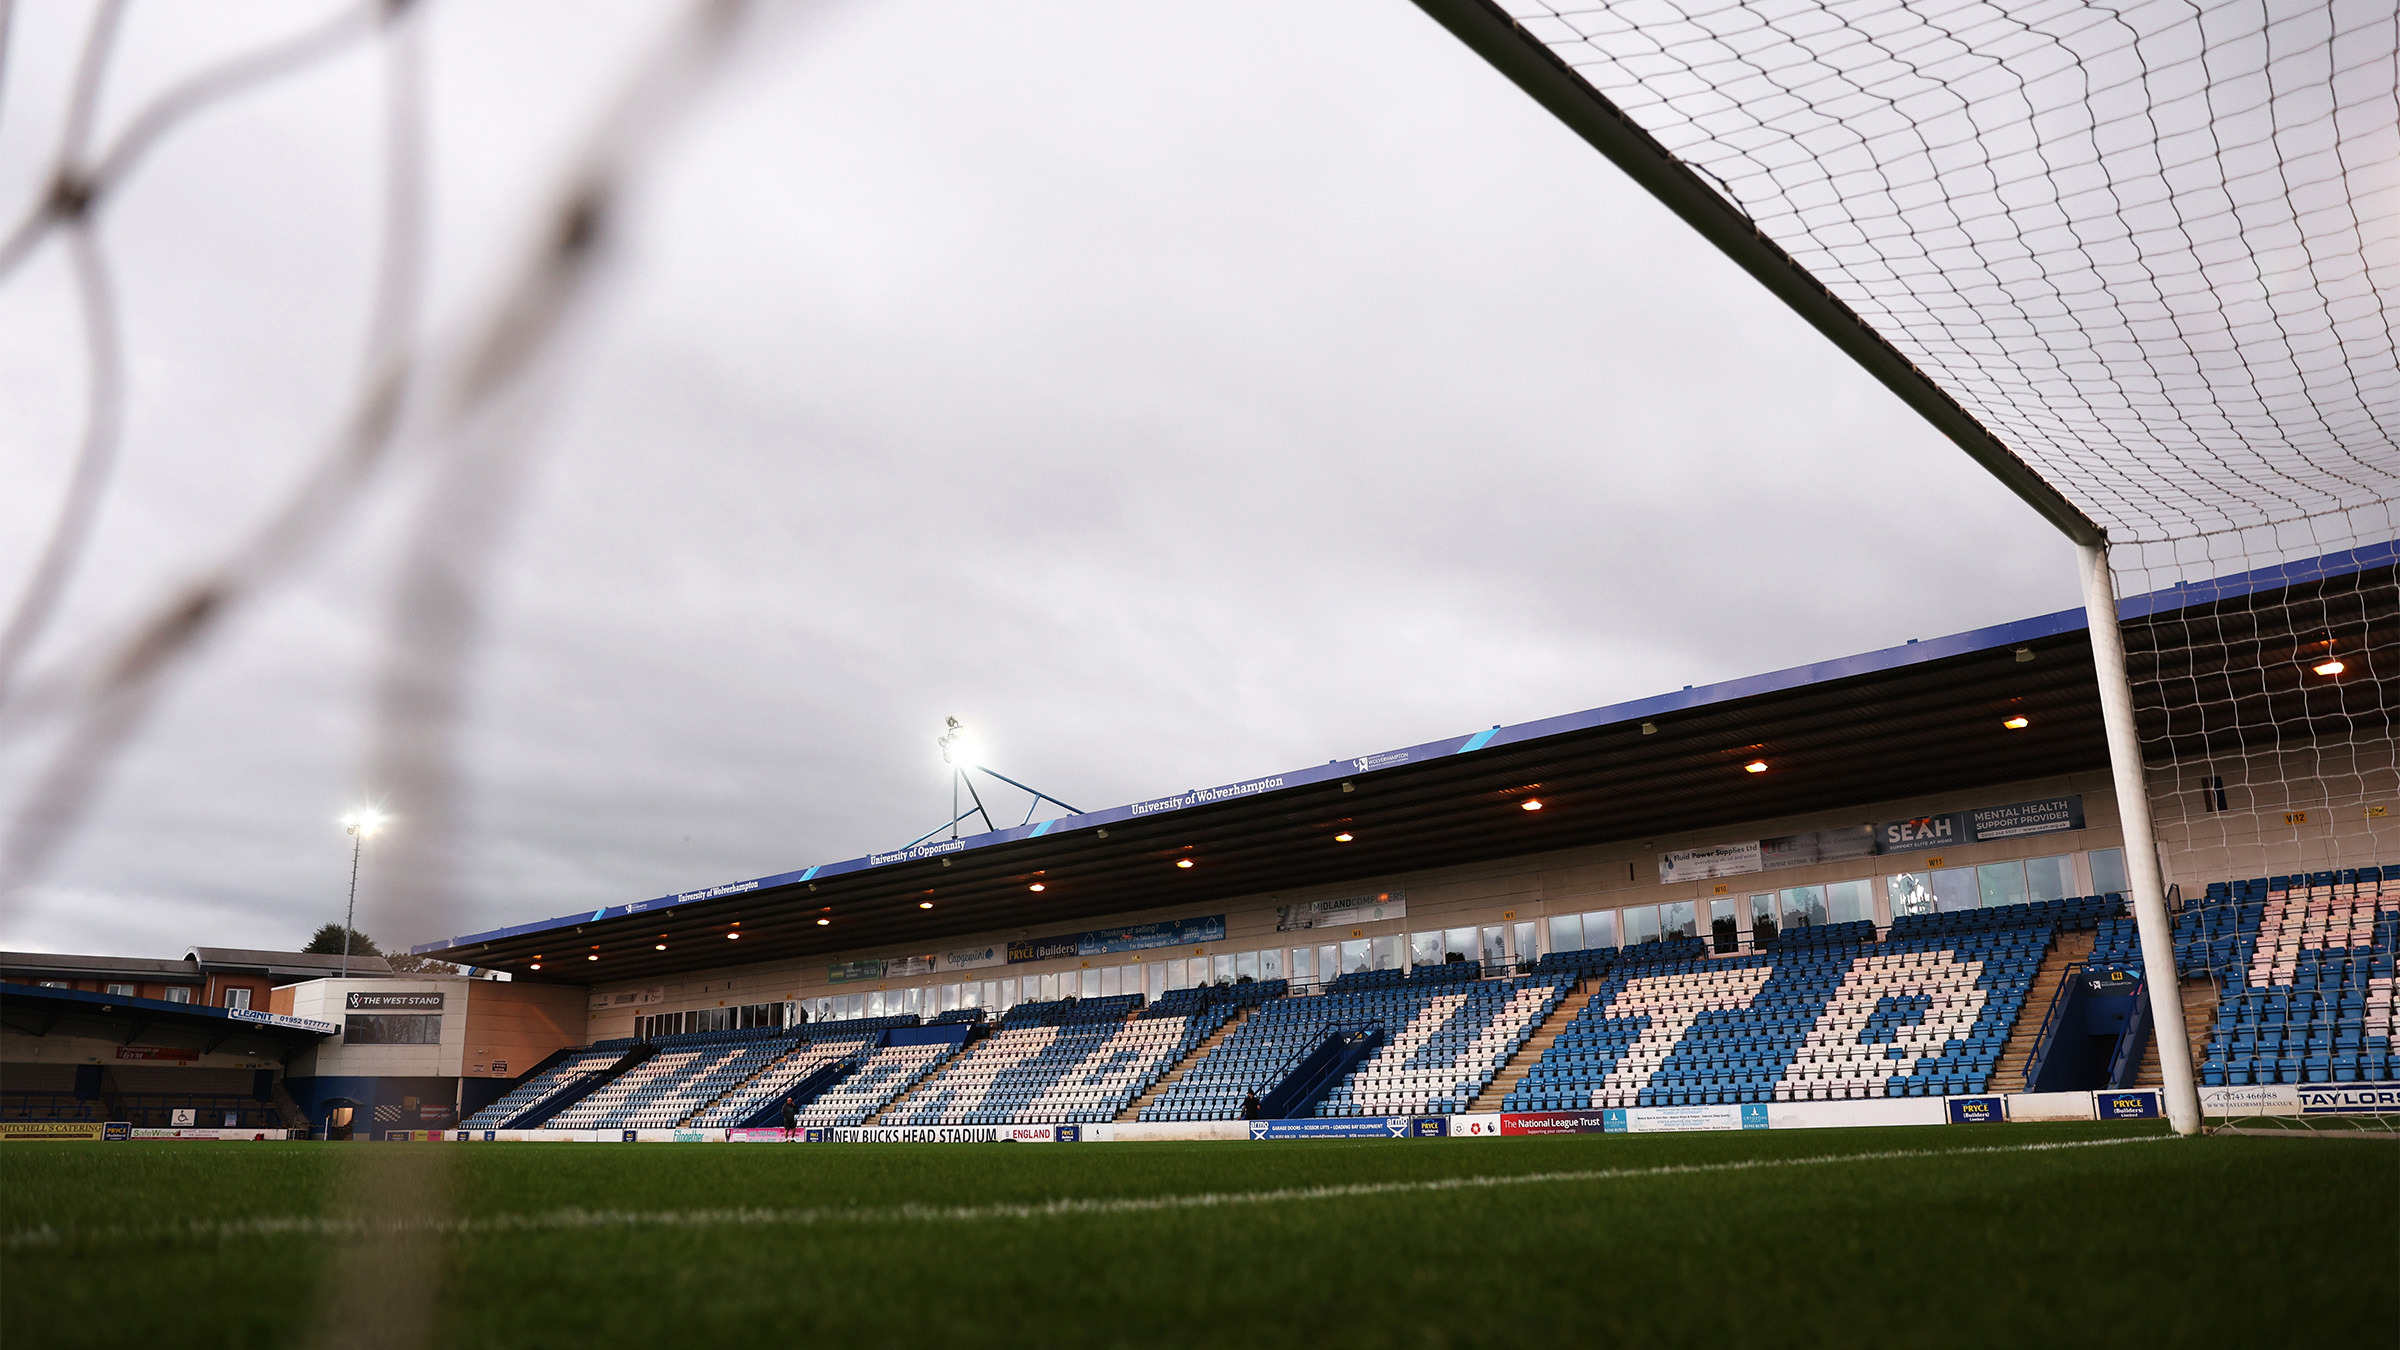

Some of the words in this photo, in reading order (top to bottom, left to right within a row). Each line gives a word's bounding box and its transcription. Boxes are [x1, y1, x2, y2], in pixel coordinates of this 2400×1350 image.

[1369, 752, 1408, 764] WOLVERHAMPTON
[1131, 797, 1183, 815] University
[1185, 793, 1196, 805] of
[1196, 777, 1283, 802] Wolverhampton
[1974, 807, 2020, 822] MENTAL
[2022, 800, 2068, 815] HEALTH
[1976, 817, 2019, 830] SUPPORT
[2020, 811, 2069, 825] PROVIDER
[2286, 814, 2305, 823] W12
[1887, 818, 1952, 843] SEAH
[870, 852, 908, 865] University
[909, 848, 918, 858] of
[918, 840, 966, 857] Opportunity
[1890, 842, 1913, 850] SUPPORT
[1674, 853, 1690, 862] Fluid
[1715, 847, 1745, 856] Supplies
[1928, 858, 1943, 868] W11
[678, 891, 706, 902] University
[706, 888, 713, 898] of
[712, 881, 759, 897] Wolverhampton
[1714, 885, 1727, 893] W10
[1313, 891, 1405, 911] MIDLANDCOMPUERS
[1100, 930, 1126, 938] Thinking
[1135, 924, 1160, 934] selling?
[1009, 948, 1034, 961] PRYCE
[1036, 942, 1078, 959] (Builders)
[947, 951, 985, 967] Capgemini
[230, 1008, 274, 1021] CLEANIT
[279, 1015, 303, 1024] 01952
[2113, 1100, 2143, 1108] PRYCE
[2297, 1092, 2400, 1105] TAYLOR
[0, 1124, 54, 1132] MITCHELL'S
[55, 1124, 101, 1132] CATERING
[1504, 1120, 1517, 1128] The
[1518, 1118, 1550, 1128] National
[1551, 1118, 1578, 1129] League
[1579, 1118, 1600, 1126] Trust
[133, 1129, 172, 1137] SafeWise
[834, 1129, 859, 1142] NEW
[862, 1129, 899, 1142] BUCKS
[903, 1129, 936, 1142] HEAD
[939, 1128, 997, 1142] STADIUM
[1012, 1129, 1050, 1139] ENGLAND
